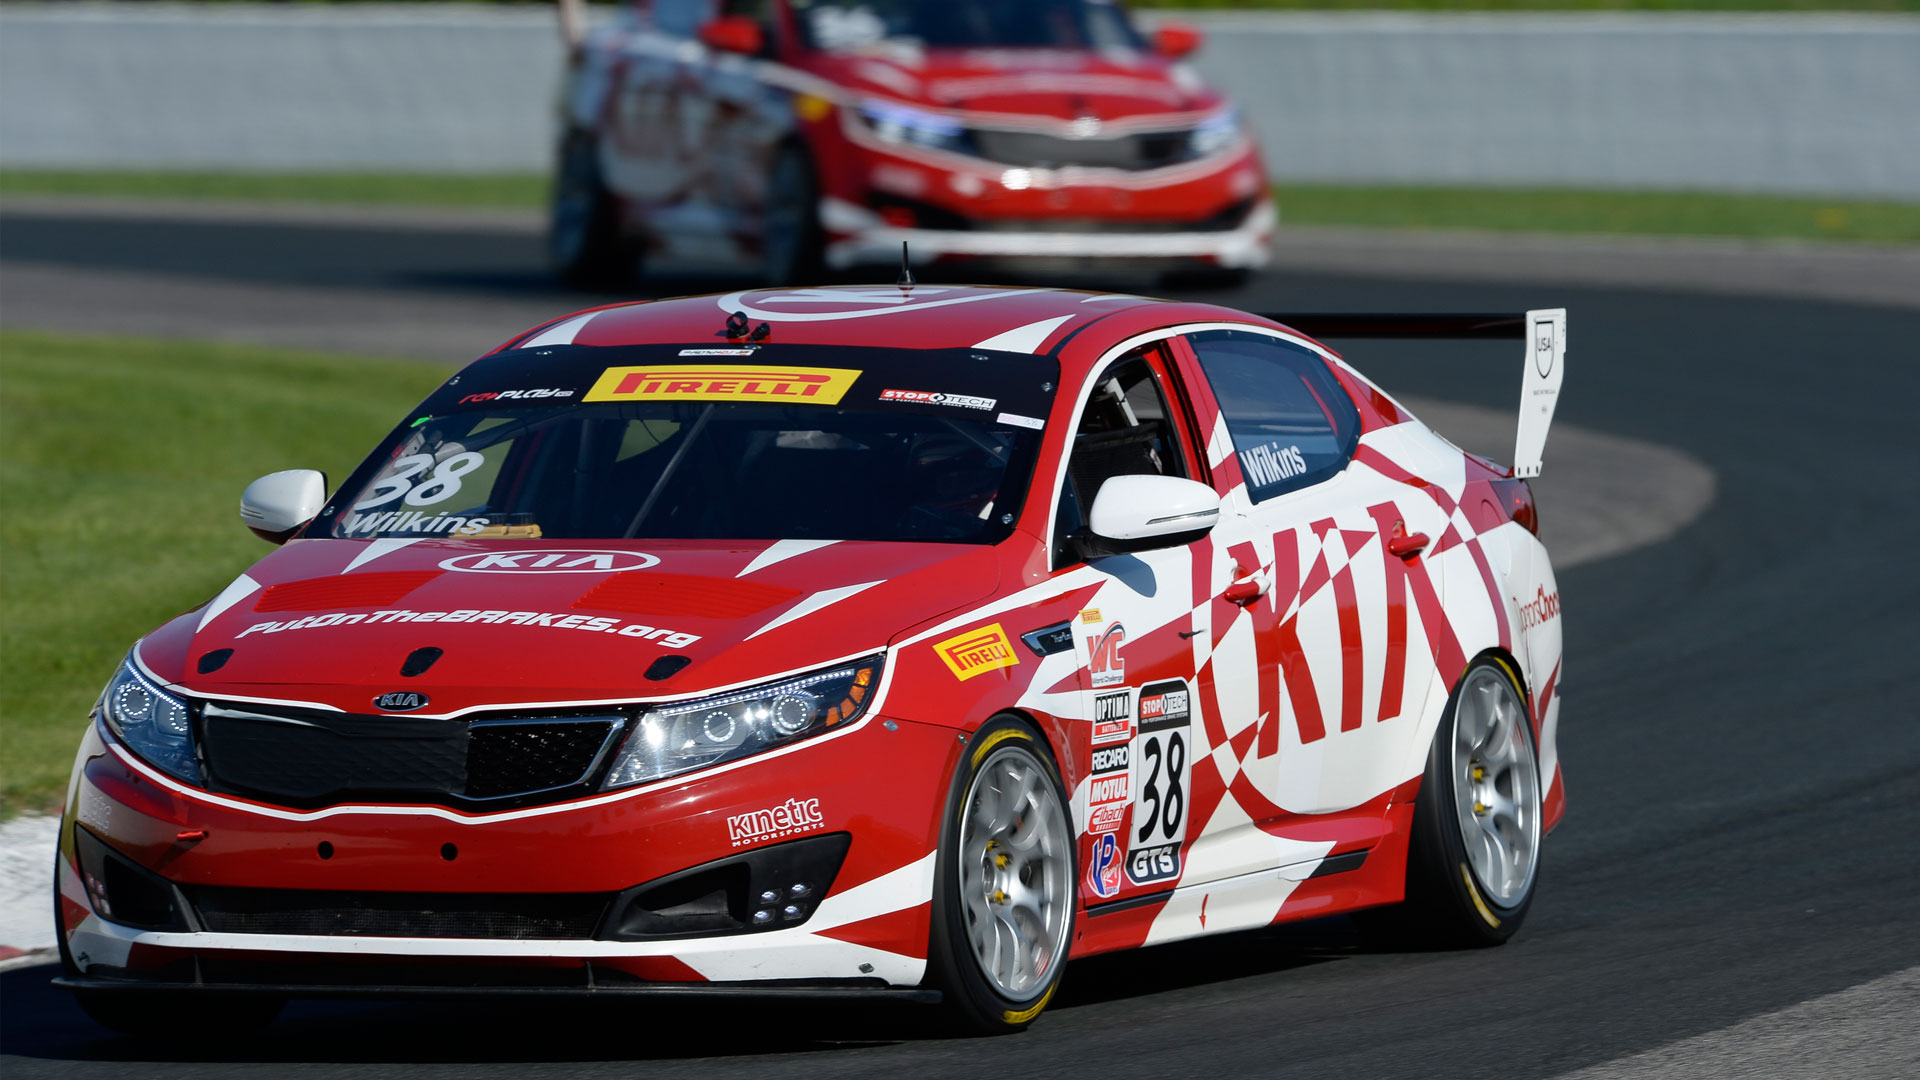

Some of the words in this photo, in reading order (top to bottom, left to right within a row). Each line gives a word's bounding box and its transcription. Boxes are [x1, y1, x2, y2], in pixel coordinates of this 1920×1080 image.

[1537, 336, 1553, 352] USA
[612, 371, 832, 397] PIRELLI
[1239, 441, 1307, 488] Wilkins
[353, 451, 485, 511] 38
[344, 511, 490, 535] Wilkins
[469, 554, 613, 570] KIA
[944, 632, 1011, 672] PIRELLI
[381, 693, 419, 707] KIA
[1096, 695, 1129, 721] OPTIMA
[1092, 747, 1128, 770] RECARO
[1091, 778, 1127, 803] MOTUL
[1138, 731, 1185, 843] 38
[732, 822, 825, 848] MOTORSPORTS
[1132, 846, 1174, 878] GTS
